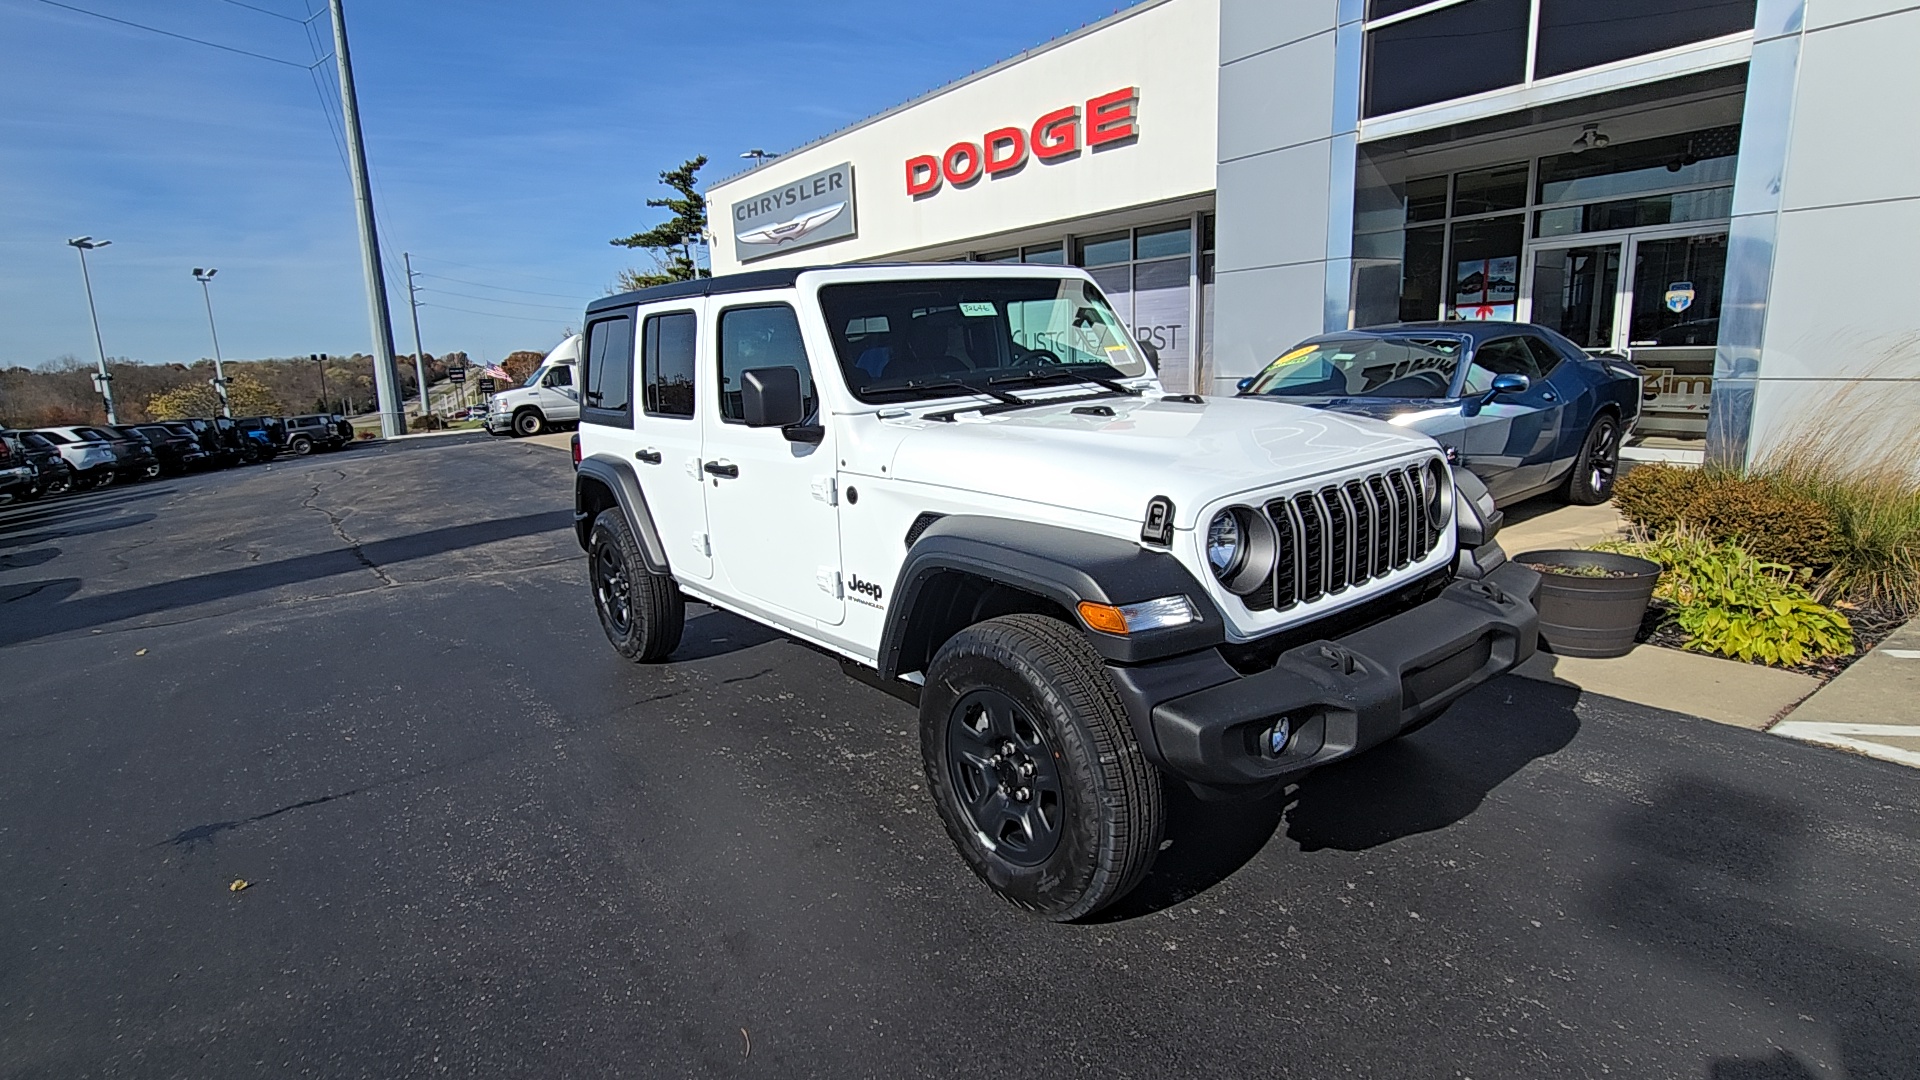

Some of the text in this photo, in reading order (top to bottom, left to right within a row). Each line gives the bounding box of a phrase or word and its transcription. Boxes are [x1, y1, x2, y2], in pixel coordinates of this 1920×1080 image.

[905, 86, 1138, 198] DODGE
[736, 172, 843, 221] CHRYSLER
[848, 573, 882, 601] Jeep
